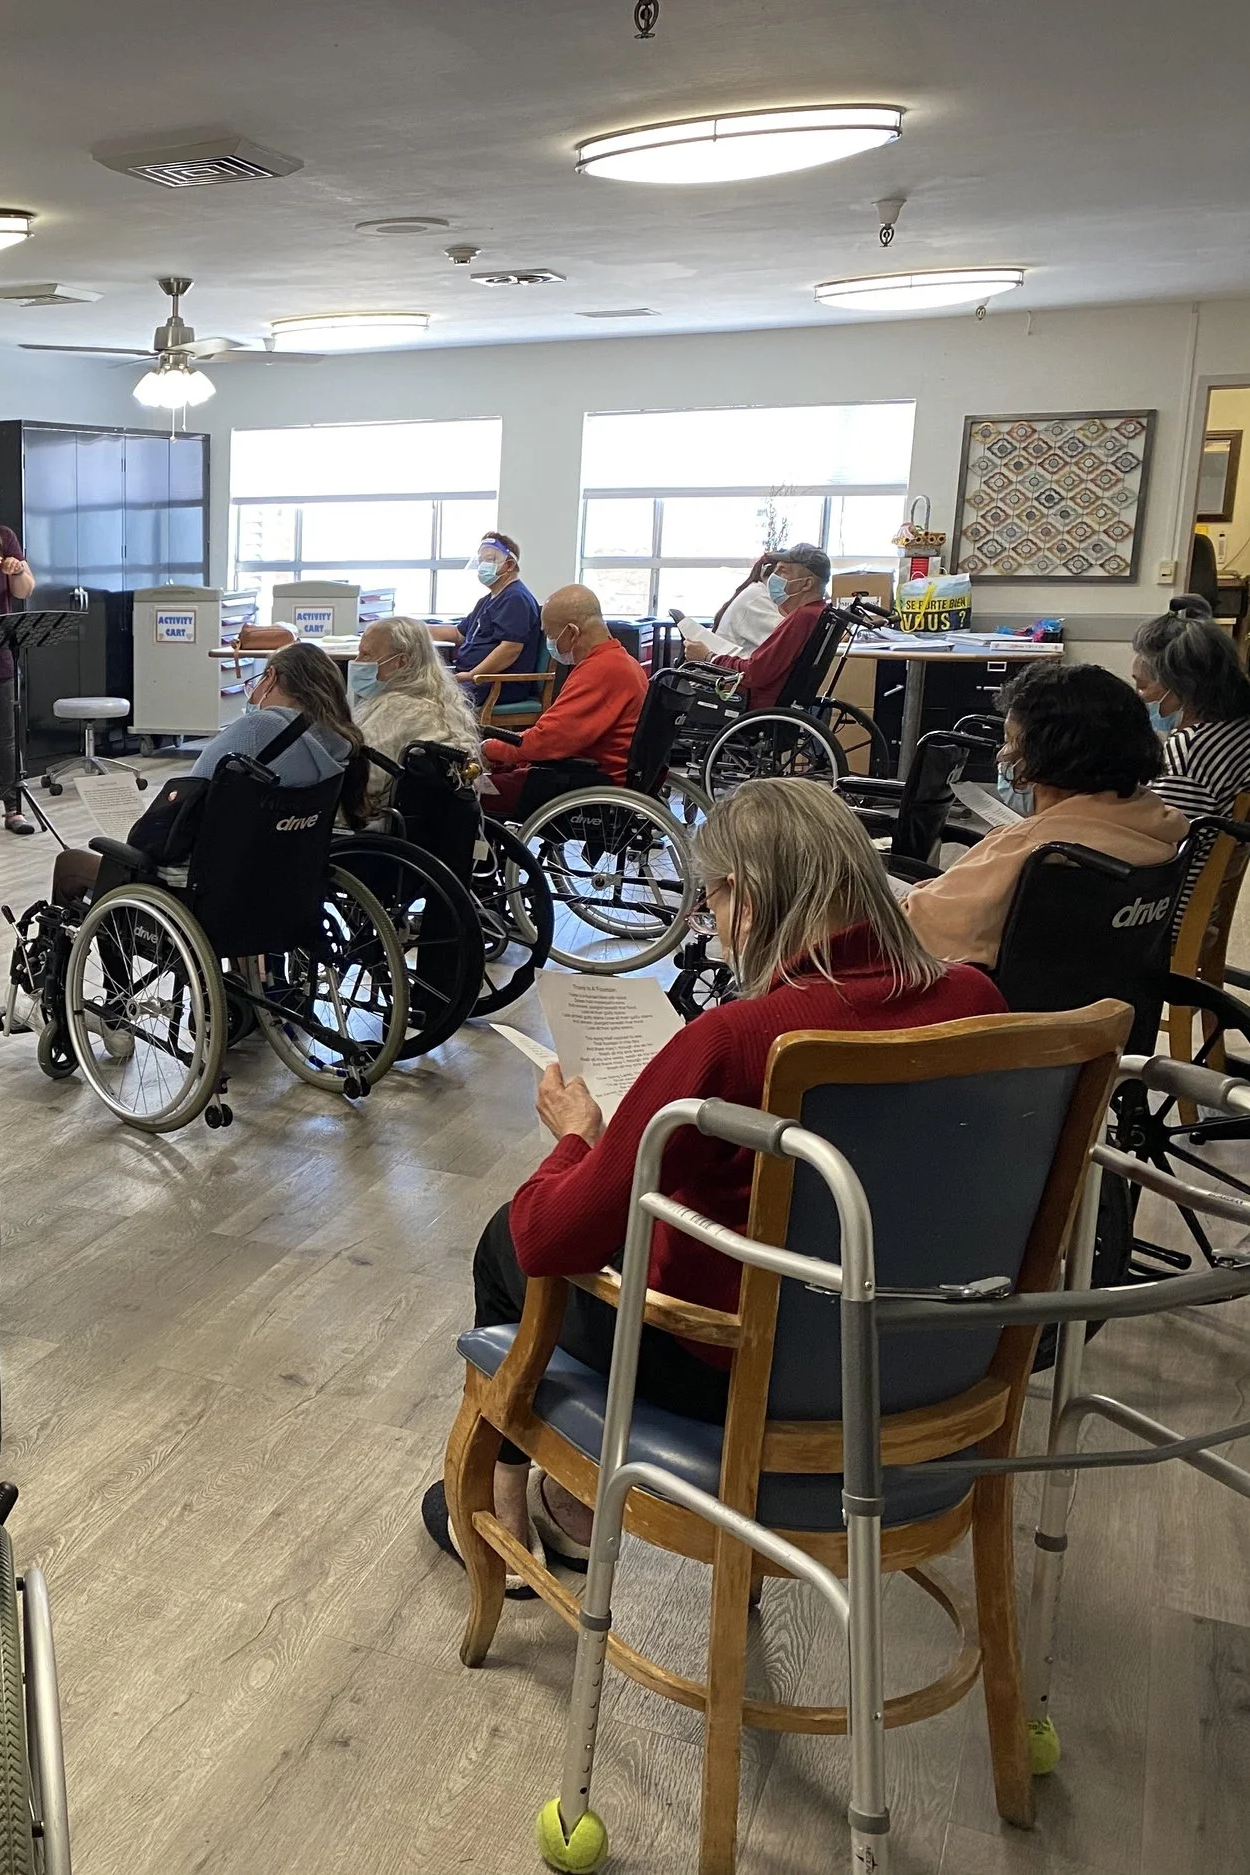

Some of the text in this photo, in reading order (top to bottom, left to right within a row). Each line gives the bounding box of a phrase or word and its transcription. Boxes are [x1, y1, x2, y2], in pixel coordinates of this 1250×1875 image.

[906, 600, 916, 610] SE
[949, 597, 966, 608] BIEN
[158, 616, 193, 624] ACTIVITY
[296, 612, 332, 620] ACTIVITY
[902, 612, 950, 631] VOUS
[165, 628, 186, 636] CART
[304, 624, 324, 632] CART
[275, 814, 319, 831] drive
[570, 814, 602, 826] drive
[1111, 896, 1170, 928] drive
[133, 925, 158, 944] drive
